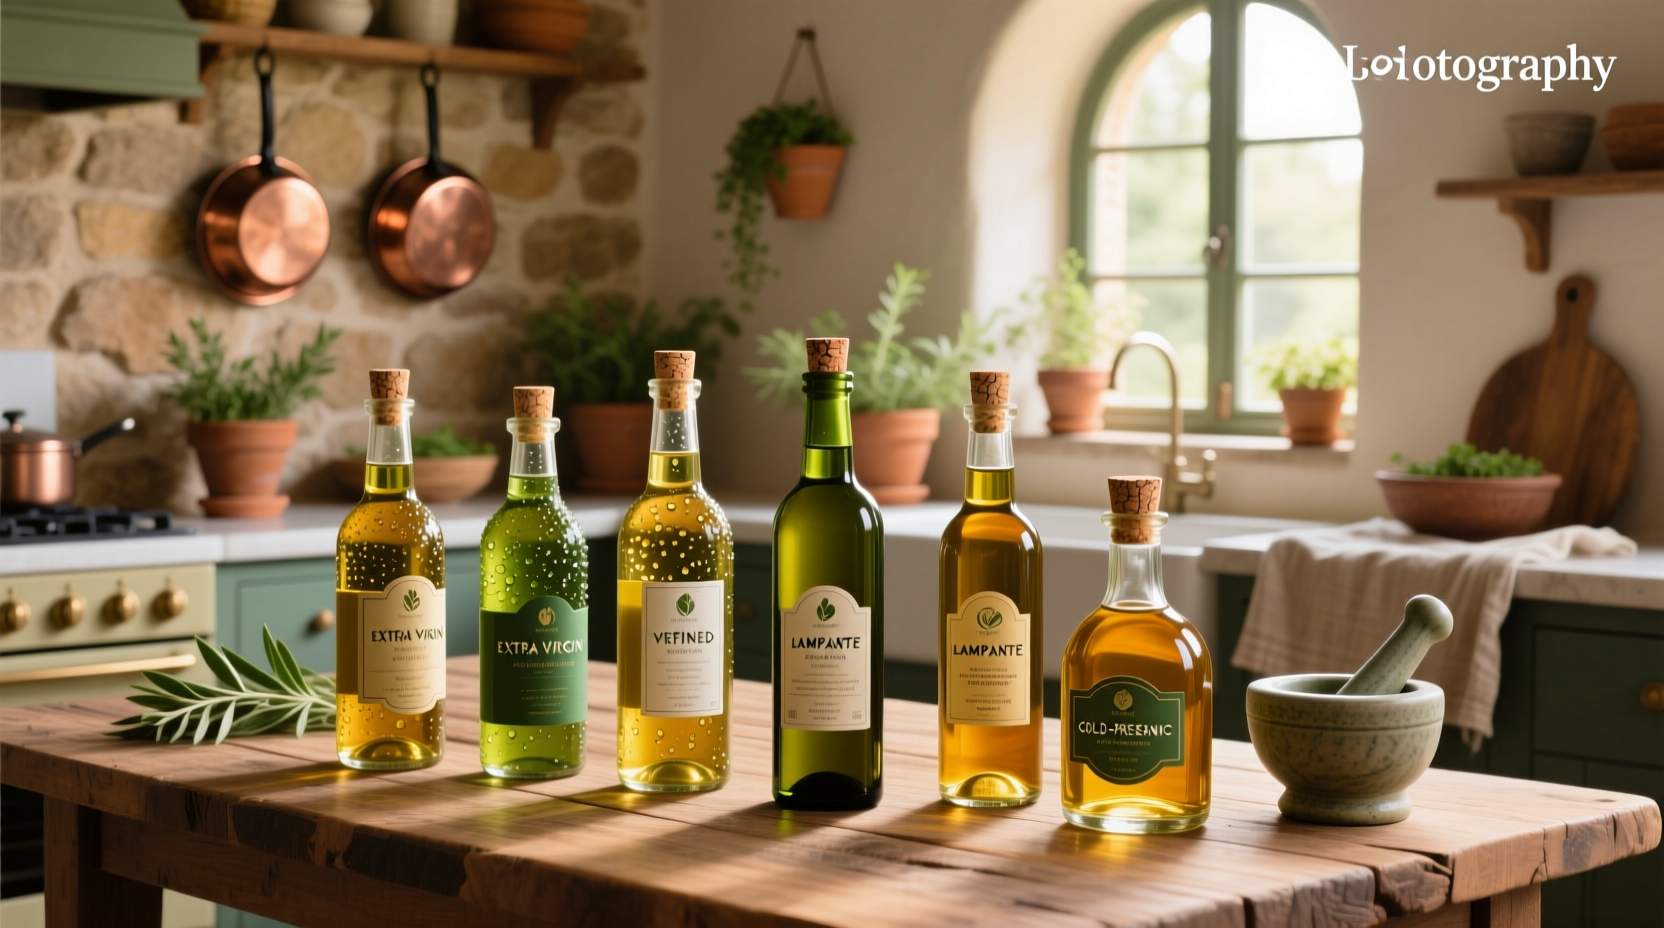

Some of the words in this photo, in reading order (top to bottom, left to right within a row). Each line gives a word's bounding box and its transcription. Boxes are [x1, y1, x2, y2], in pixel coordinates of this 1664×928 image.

[371, 629, 412, 642] EXTRA
[497, 641, 538, 655] EXTRA
[791, 637, 860, 649] LAMPANTE
[953, 644, 1023, 656] LAMPANTE
